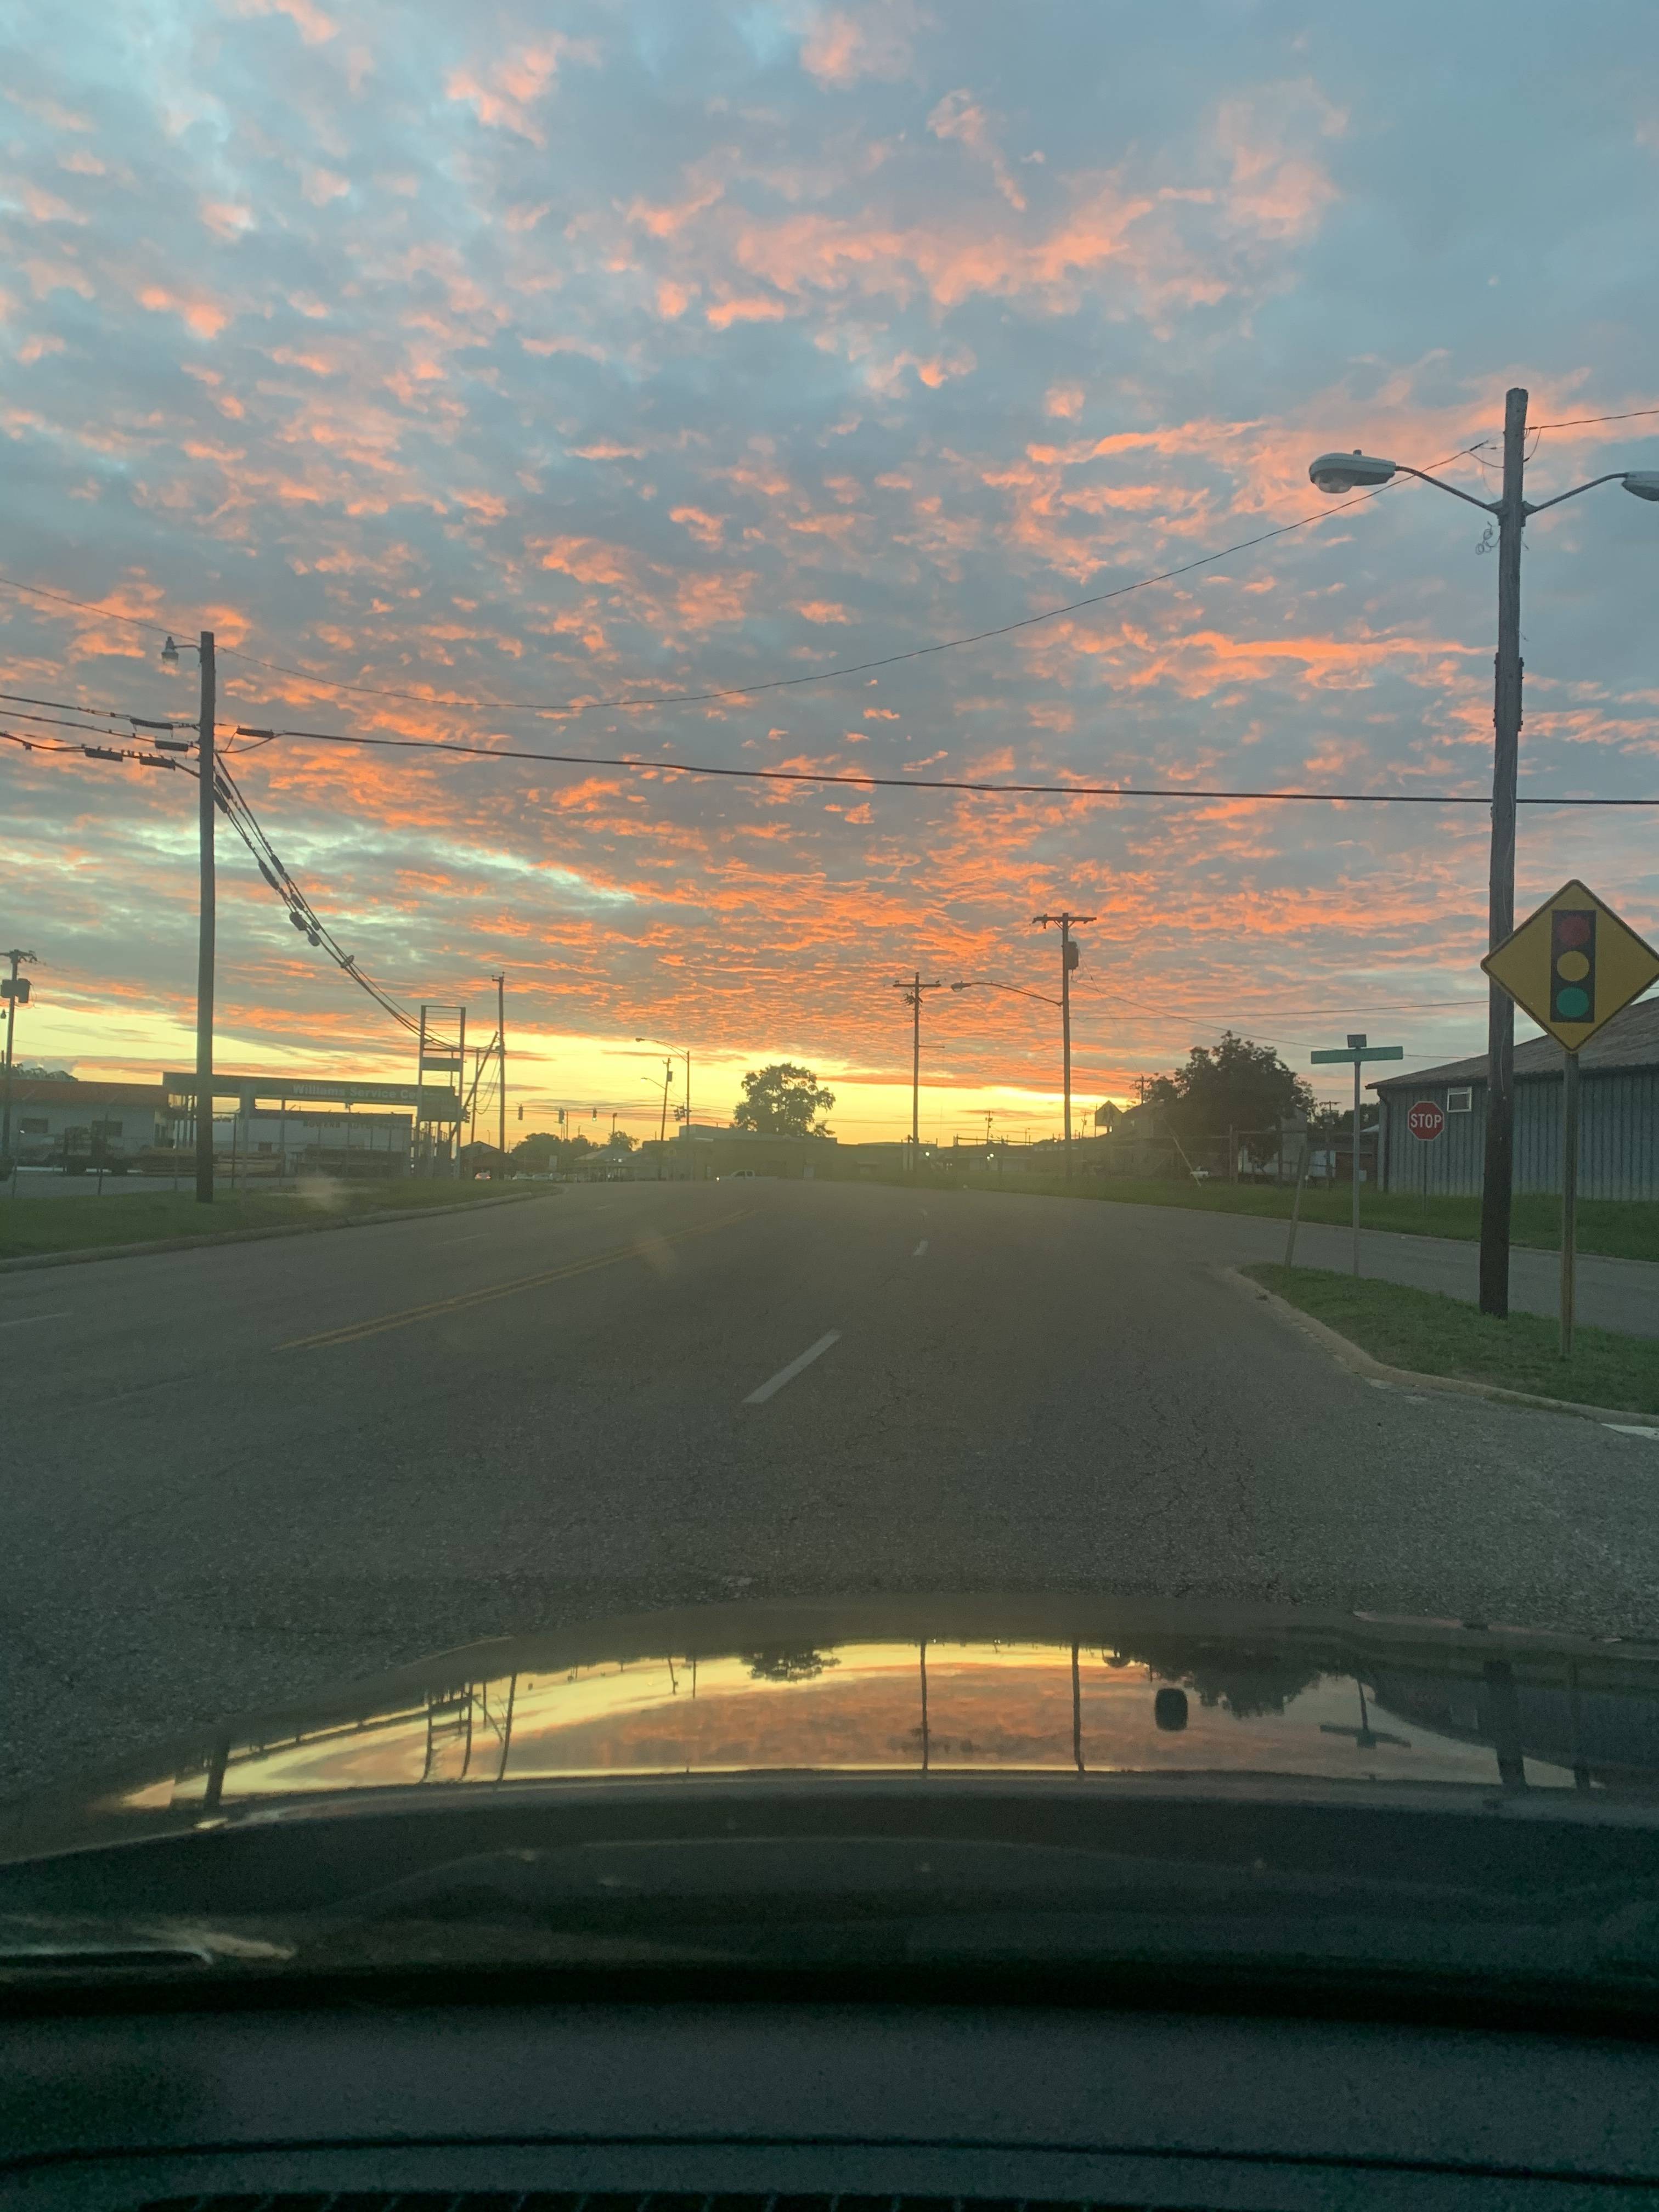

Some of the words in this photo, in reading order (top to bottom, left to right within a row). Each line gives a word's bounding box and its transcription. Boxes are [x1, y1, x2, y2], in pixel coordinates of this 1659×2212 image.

[292, 1084, 346, 1096] Williams
[349, 1086, 396, 1098] Service
[1410, 1114, 1442, 1128] STOP
